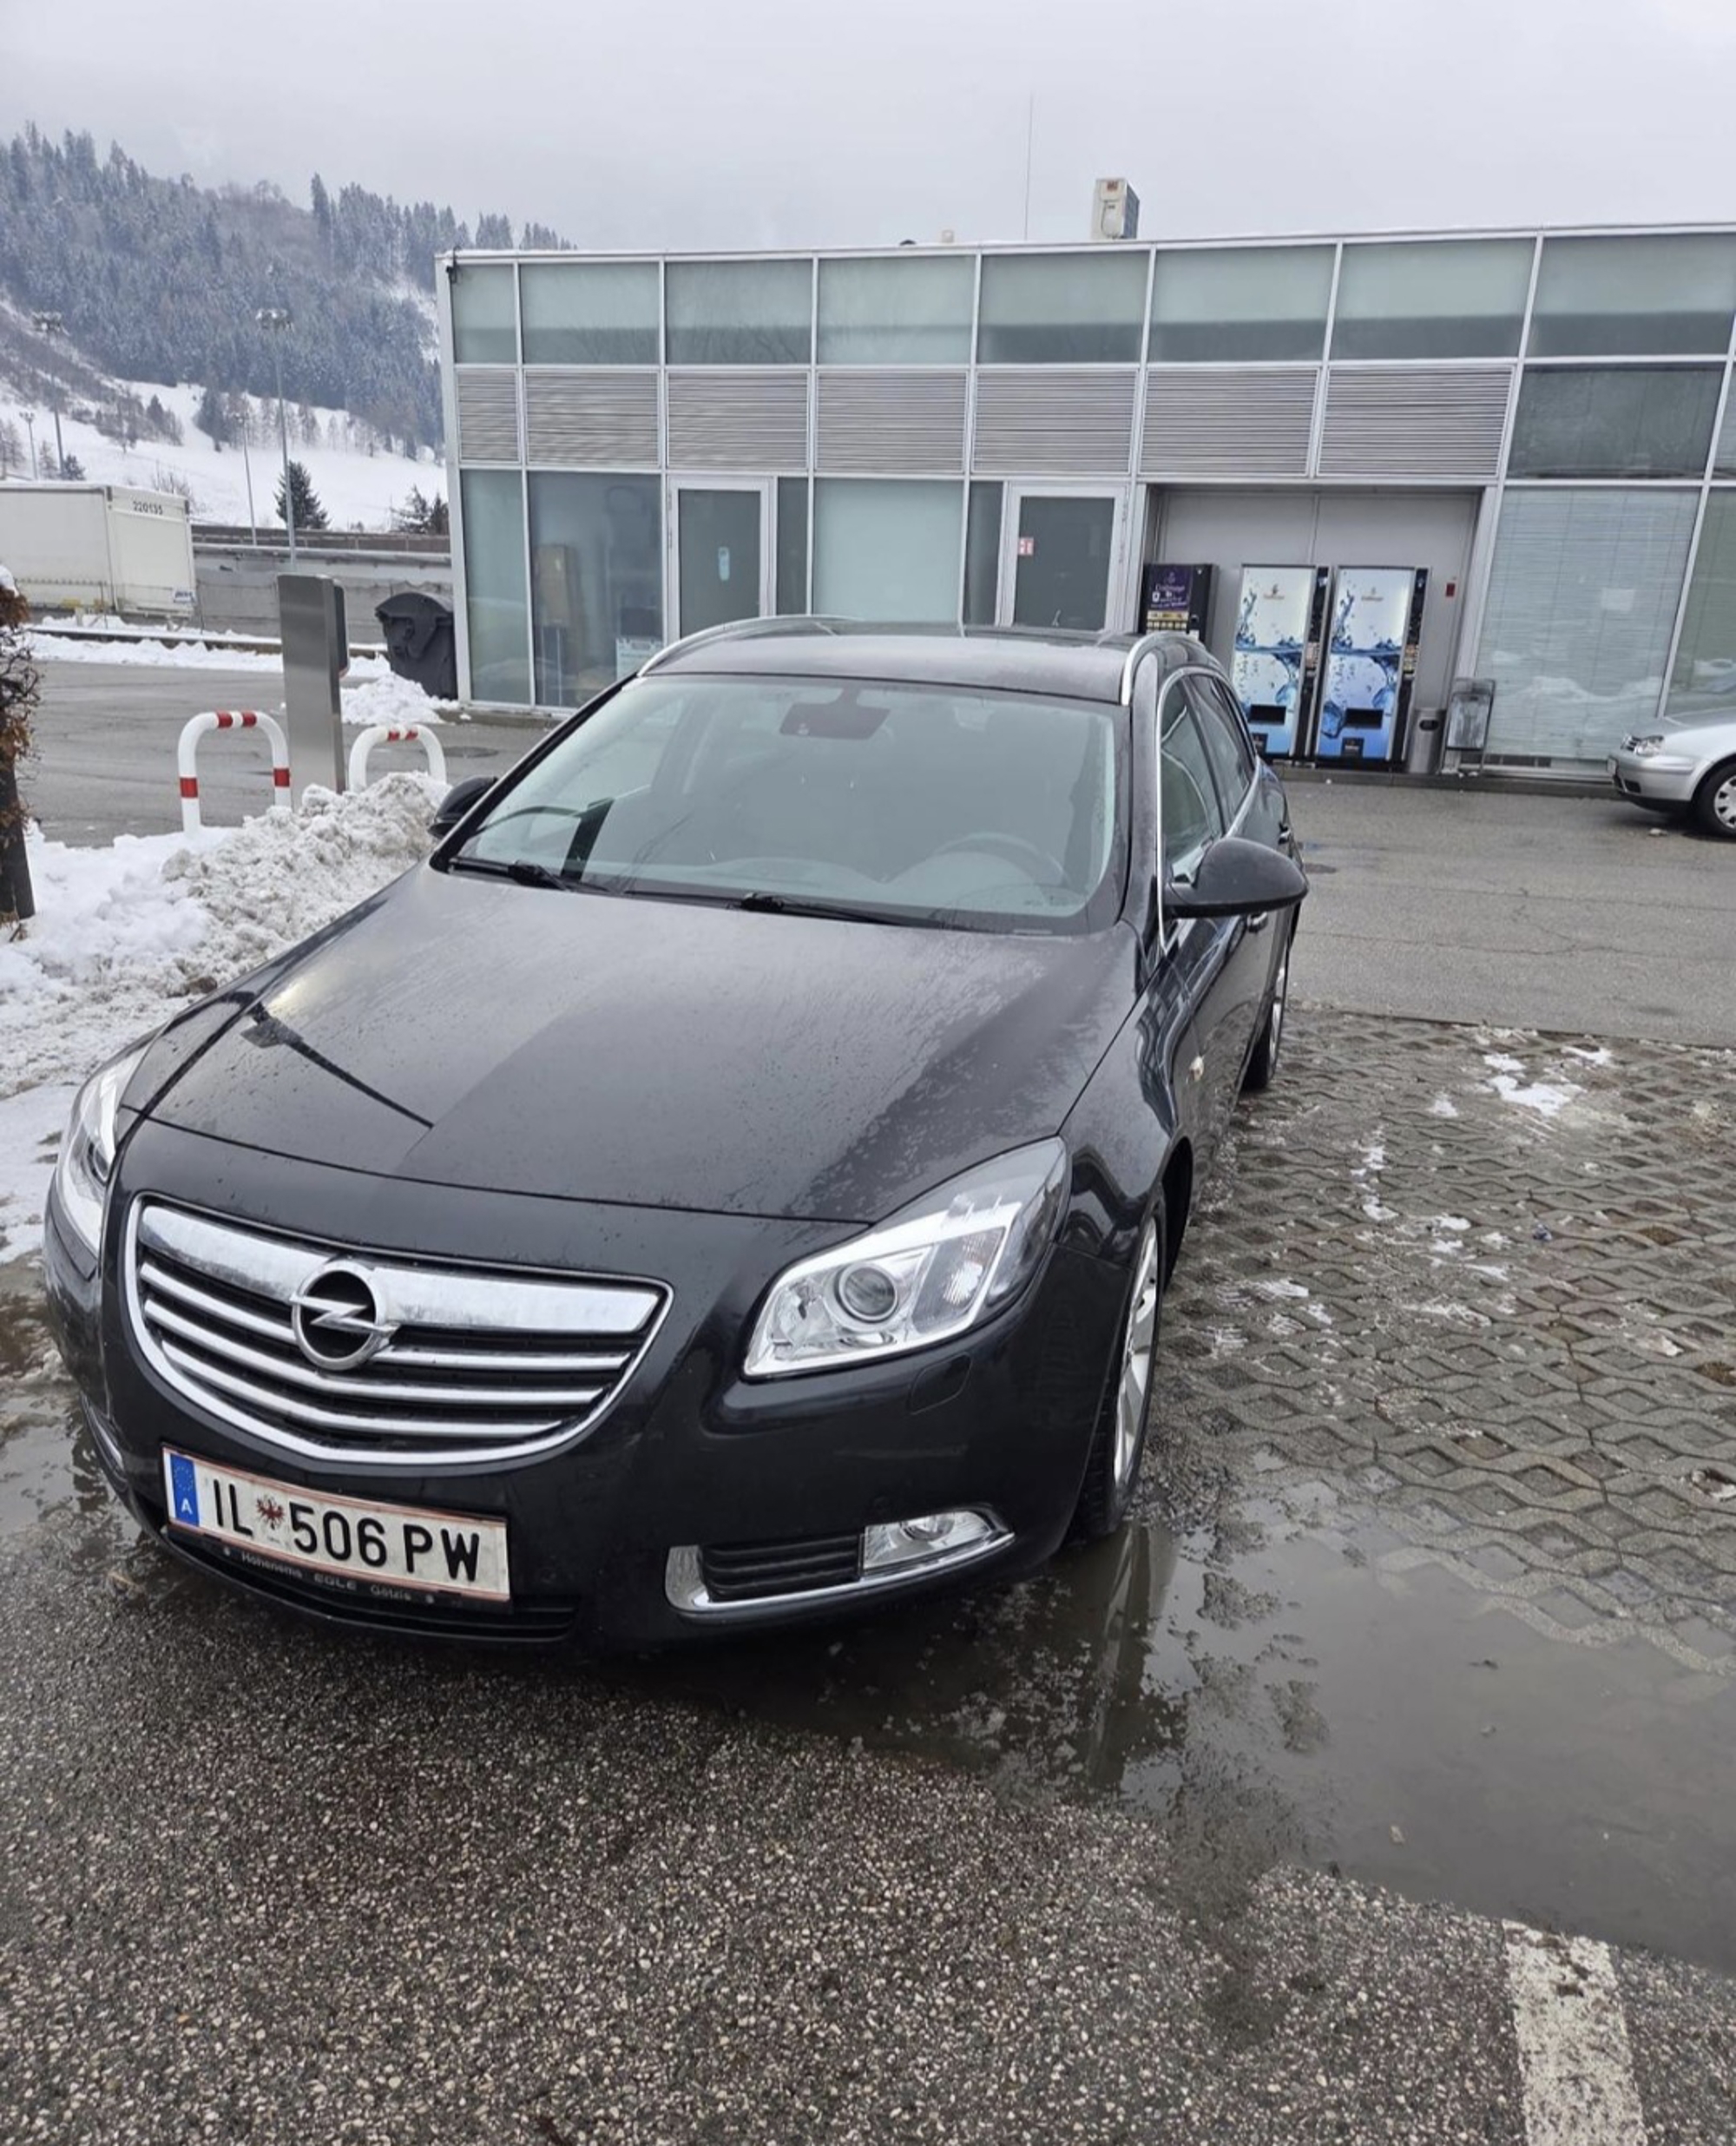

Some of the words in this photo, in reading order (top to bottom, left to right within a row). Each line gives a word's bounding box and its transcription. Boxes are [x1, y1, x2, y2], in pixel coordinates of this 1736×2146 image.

[181, 1498, 193, 1515] A
[213, 1478, 253, 1537] IL
[289, 1502, 387, 1568] 506
[403, 1523, 480, 1583] PW
